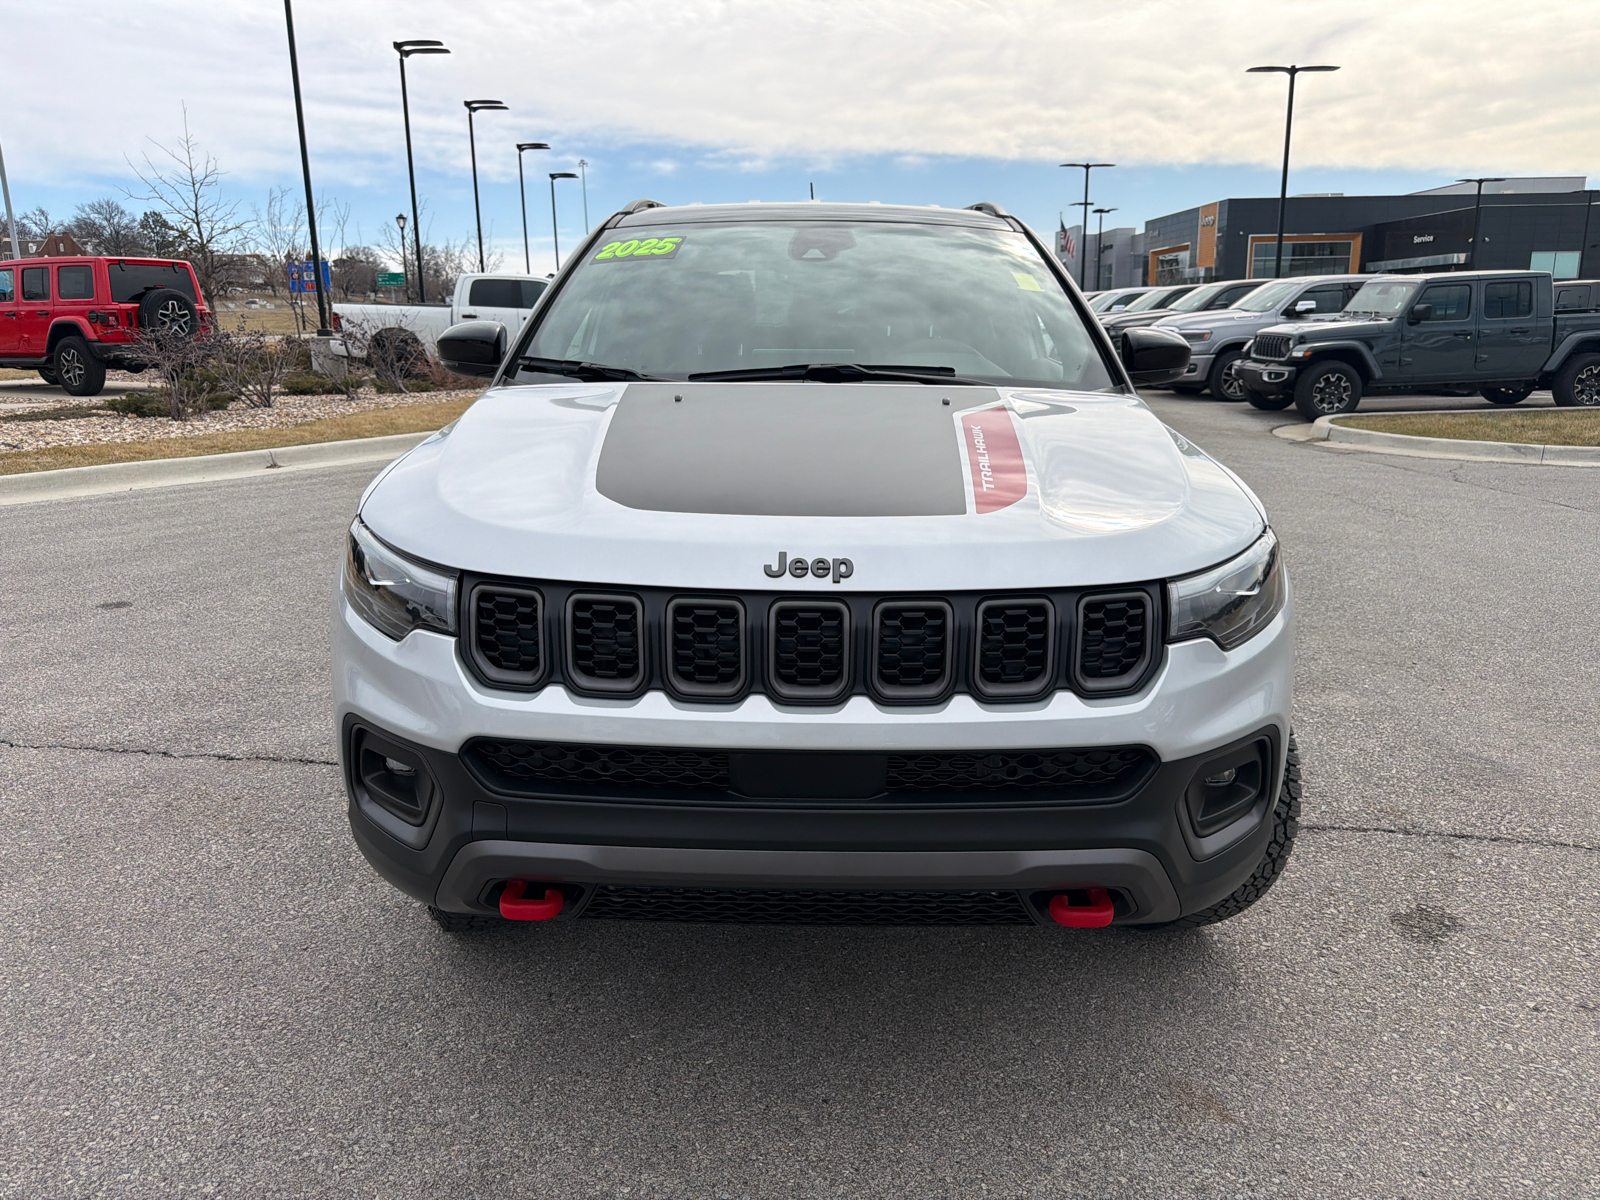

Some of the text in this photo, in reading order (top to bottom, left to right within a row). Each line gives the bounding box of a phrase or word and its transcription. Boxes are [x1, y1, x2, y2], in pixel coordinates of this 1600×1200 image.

[595, 237, 683, 260] 2025
[1413, 234, 1434, 244] Service
[970, 424, 995, 493] TRAILHAWK
[763, 551, 854, 584] Jeep
